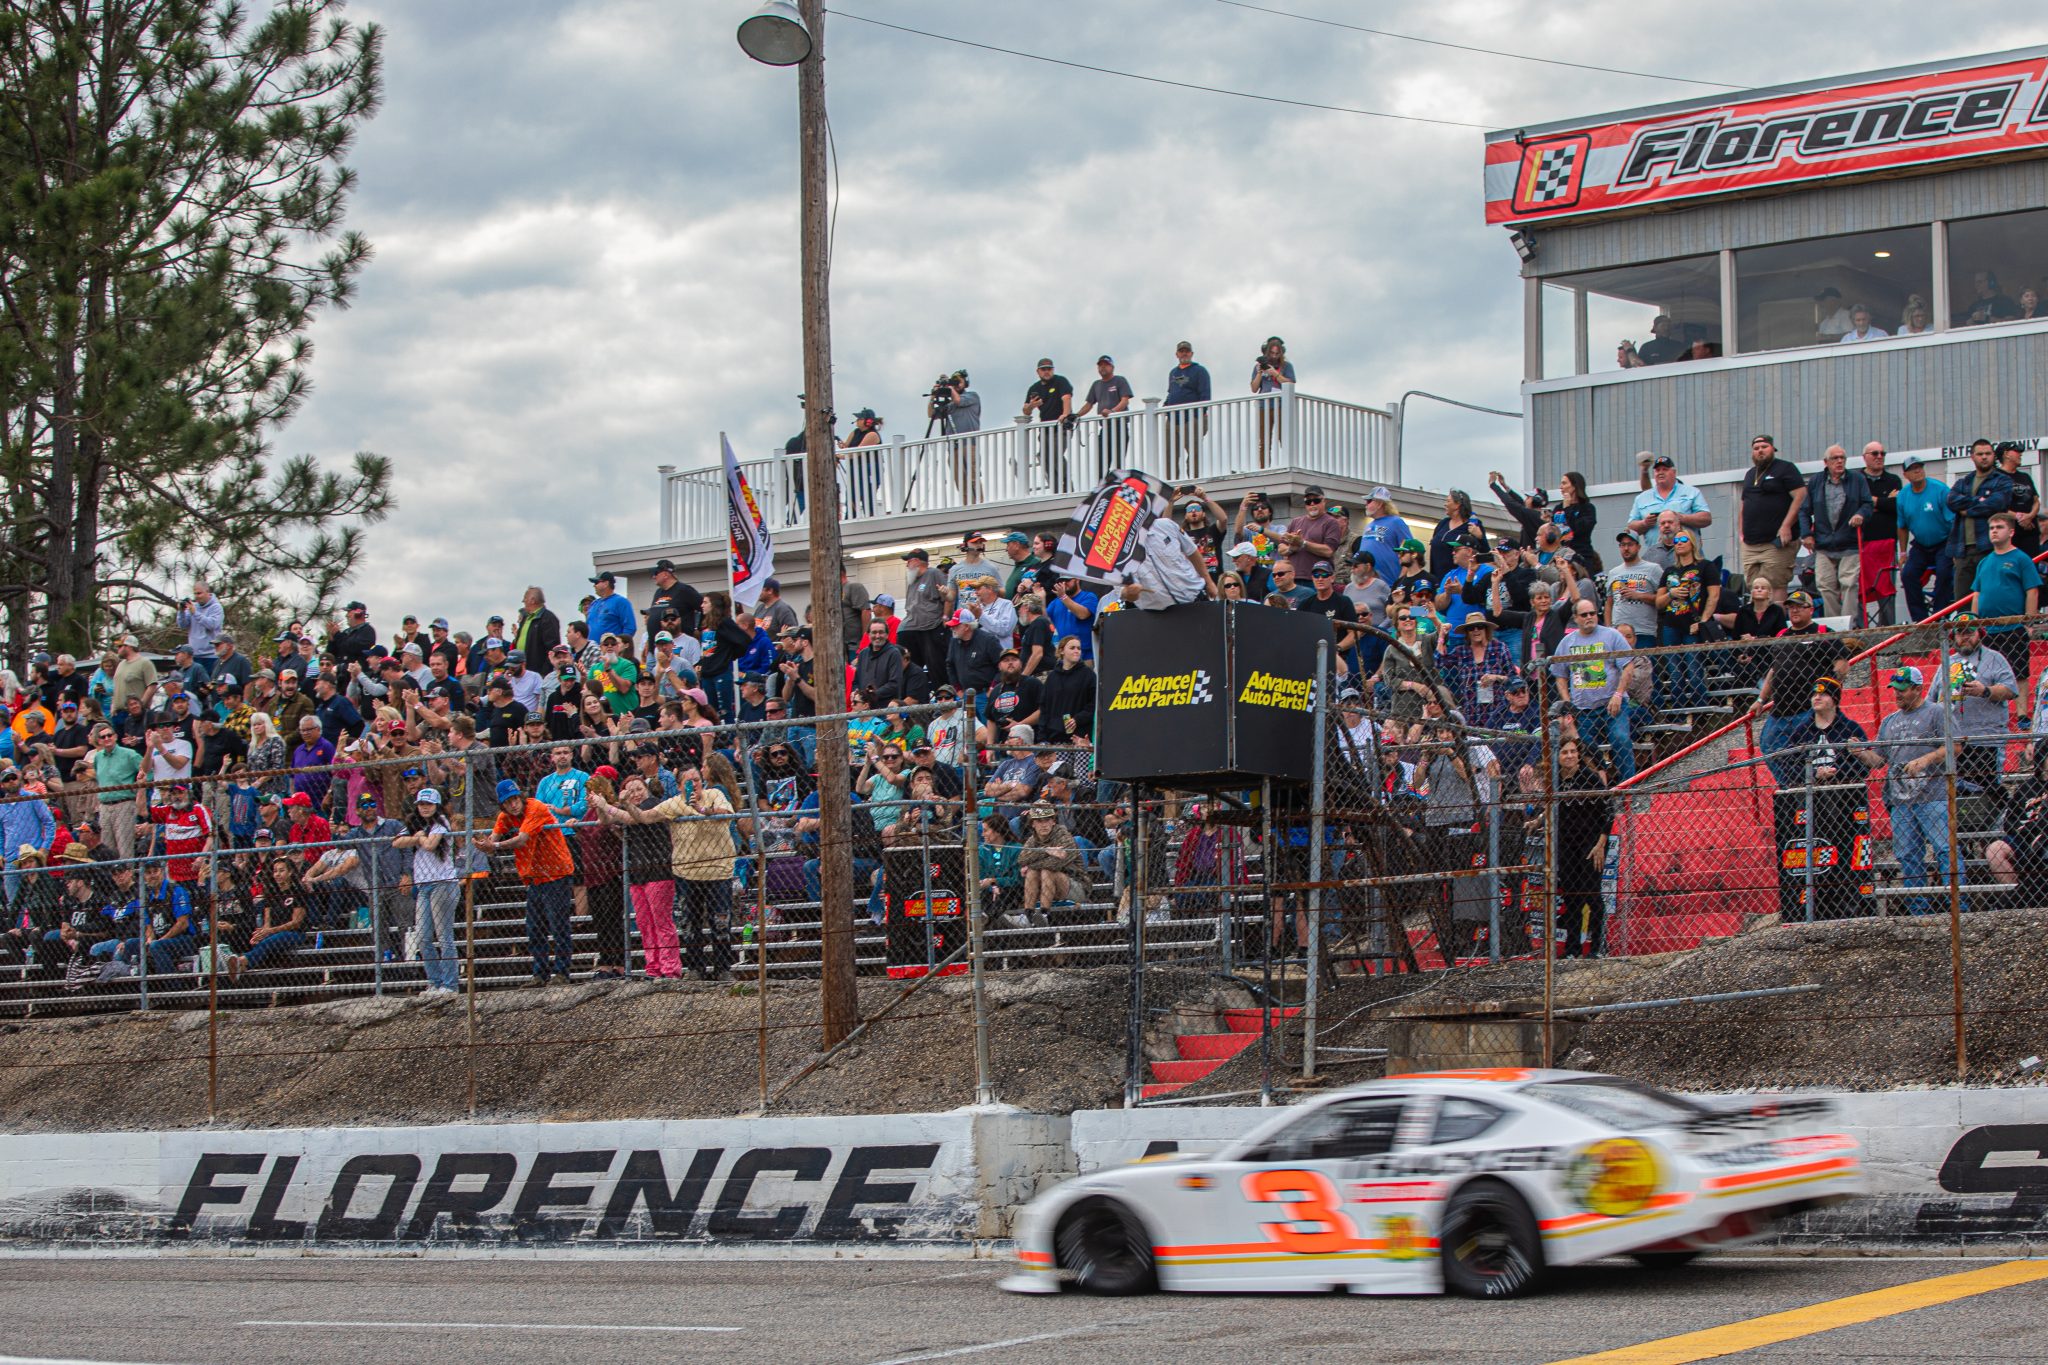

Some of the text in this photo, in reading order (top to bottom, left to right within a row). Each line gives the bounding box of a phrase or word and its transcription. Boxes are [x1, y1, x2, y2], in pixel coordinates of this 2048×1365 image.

[1618, 81, 2022, 186] Florence
[1117, 674, 1191, 695] Advance
[1246, 670, 1307, 696] Advance
[1108, 689, 1188, 711] Auto Parts
[1238, 687, 1304, 711] Auto Parts
[167, 1144, 941, 1242] FLORENCE
[1240, 1168, 1360, 1254] 3
